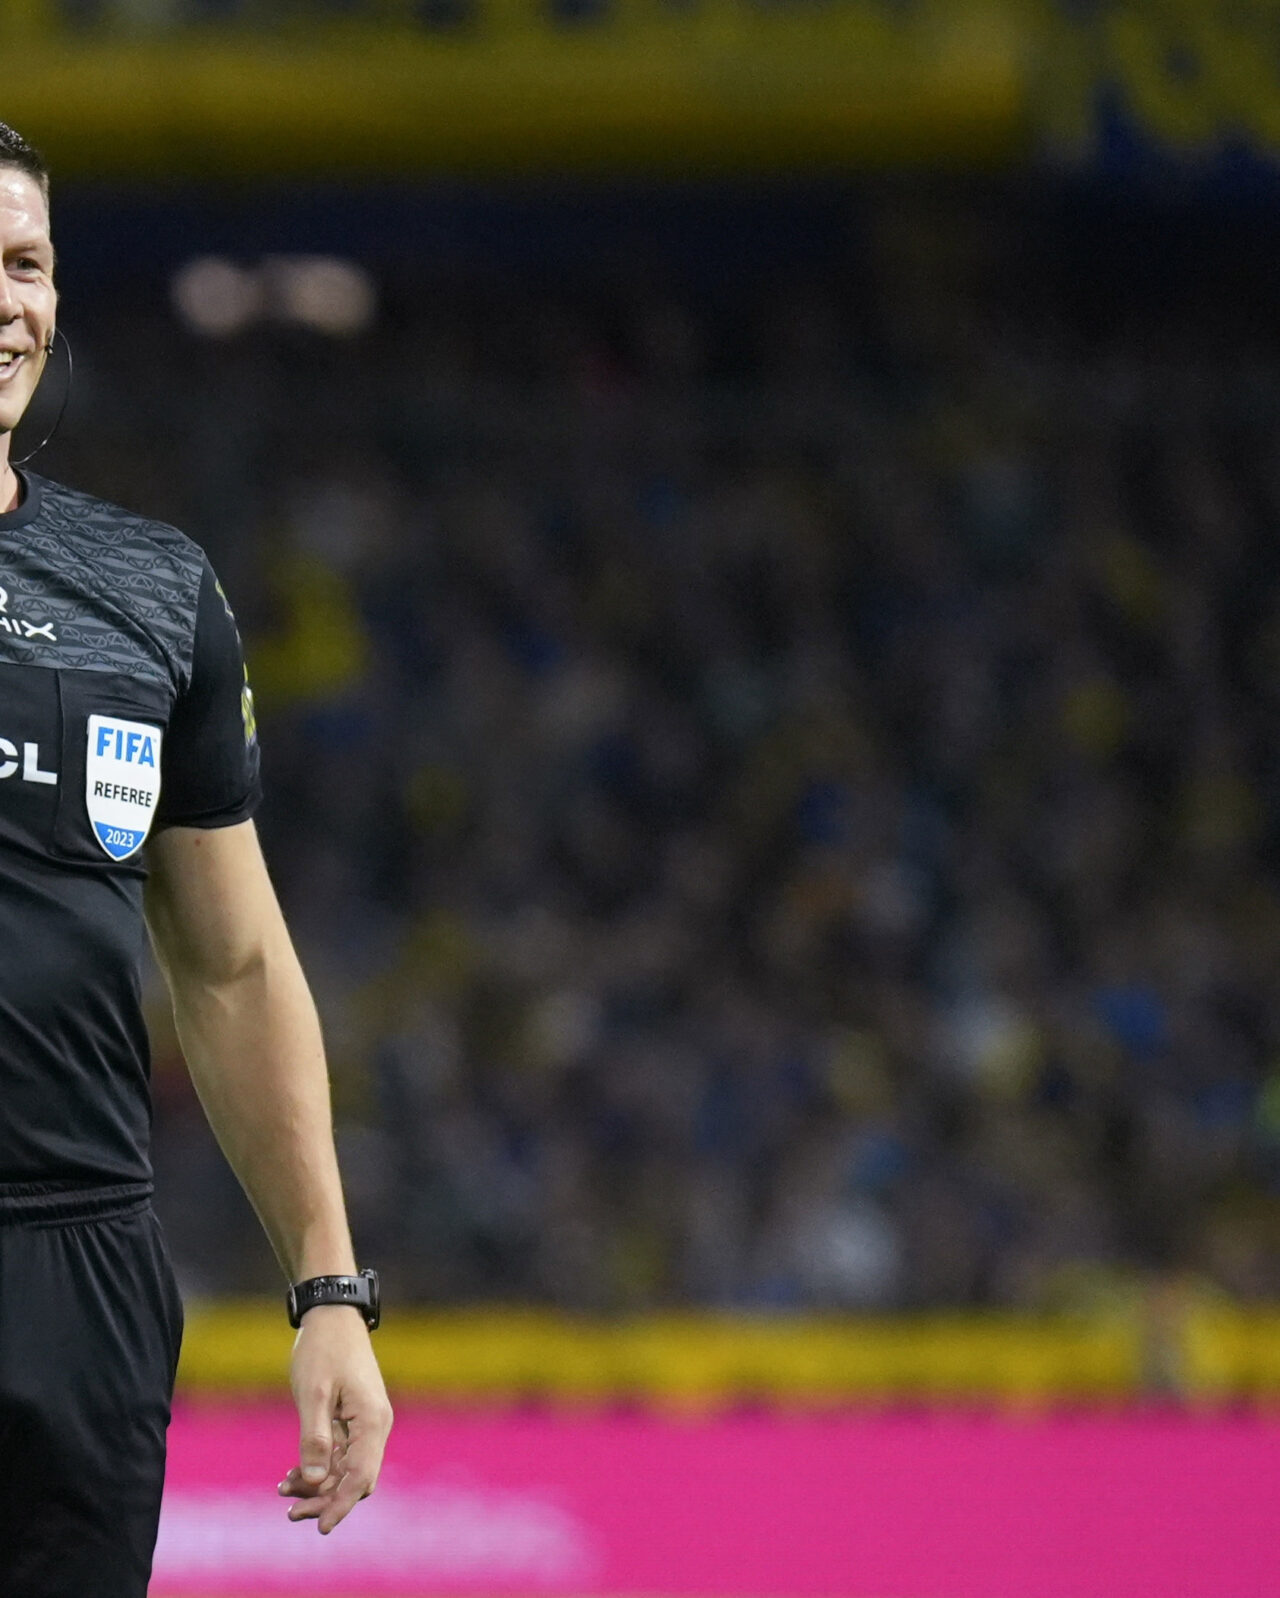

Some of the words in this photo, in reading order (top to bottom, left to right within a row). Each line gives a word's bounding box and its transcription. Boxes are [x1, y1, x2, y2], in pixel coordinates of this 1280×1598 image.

[96, 726, 155, 768] FIFA
[94, 780, 153, 808] REFEREE
[105, 828, 135, 848] 2023
